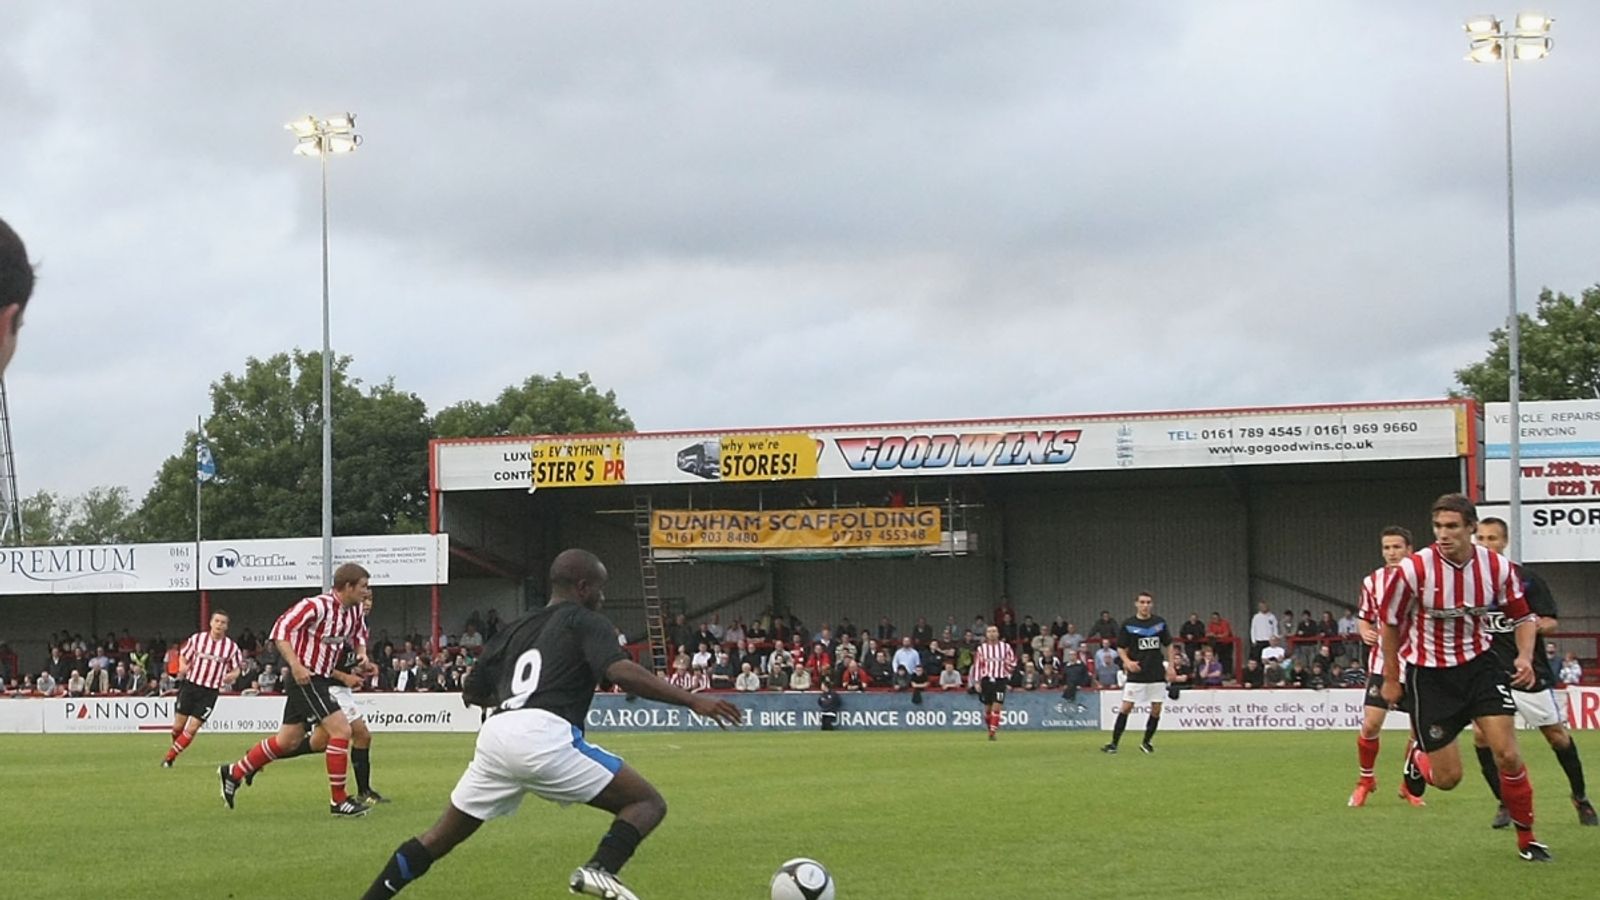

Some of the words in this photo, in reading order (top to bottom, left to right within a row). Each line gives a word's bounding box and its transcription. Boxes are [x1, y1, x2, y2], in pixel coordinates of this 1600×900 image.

[1493, 413, 1544, 423] VEICLE
[1551, 412, 1600, 422] REPAIRS
[1167, 430, 1197, 441] TEL:
[1201, 429, 1234, 440] 0161
[1239, 428, 1264, 439] 789
[1268, 426, 1302, 438] 4545
[1314, 425, 1347, 436] 0161
[1352, 423, 1378, 434] 969
[1383, 422, 1418, 434] 9660
[1521, 427, 1577, 437] ERVICING
[549, 444, 611, 458] EVRYTHIN
[721, 440, 743, 454] why
[748, 438, 779, 450] we're
[834, 430, 1082, 471] GOODWINS
[1208, 440, 1374, 455] www.gogoodwins.co.uk
[603, 459, 624, 481] PR
[722, 453, 798, 477] STORES!
[658, 514, 761, 531] DUNHAM
[769, 511, 934, 531] SCAFFOLDING
[665, 533, 694, 544] 0161
[700, 533, 722, 543] 903
[726, 532, 759, 543] 8480
[832, 530, 872, 542] 07739
[878, 529, 926, 542] 455348
[169, 547, 190, 557] 0161
[173, 562, 191, 572] 929
[168, 578, 190, 588] 3955
[1486, 613, 1512, 632] IG
[1138, 637, 1160, 650] AIG
[501, 648, 542, 710] 9
[65, 702, 177, 719] PANNON
[1164, 702, 1222, 714] services
[1228, 703, 1241, 714] at
[1246, 703, 1268, 714] the
[1274, 702, 1304, 714] click
[1311, 703, 1325, 713] of
[1330, 705, 1339, 713] a
[1345, 703, 1363, 713] bu
[212, 720, 233, 730] 0161
[237, 720, 254, 730] 909
[256, 720, 279, 730] 3000
[363, 710, 451, 726] .vispa.com/it
[587, 709, 680, 727] CAROLE
[760, 711, 796, 727] BIKE
[803, 711, 899, 727] INURANCE
[905, 710, 947, 726] 0800
[952, 710, 982, 726] 298
[998, 710, 1029, 726] 500
[1179, 715, 1364, 730] www.trafford.gov.uk
